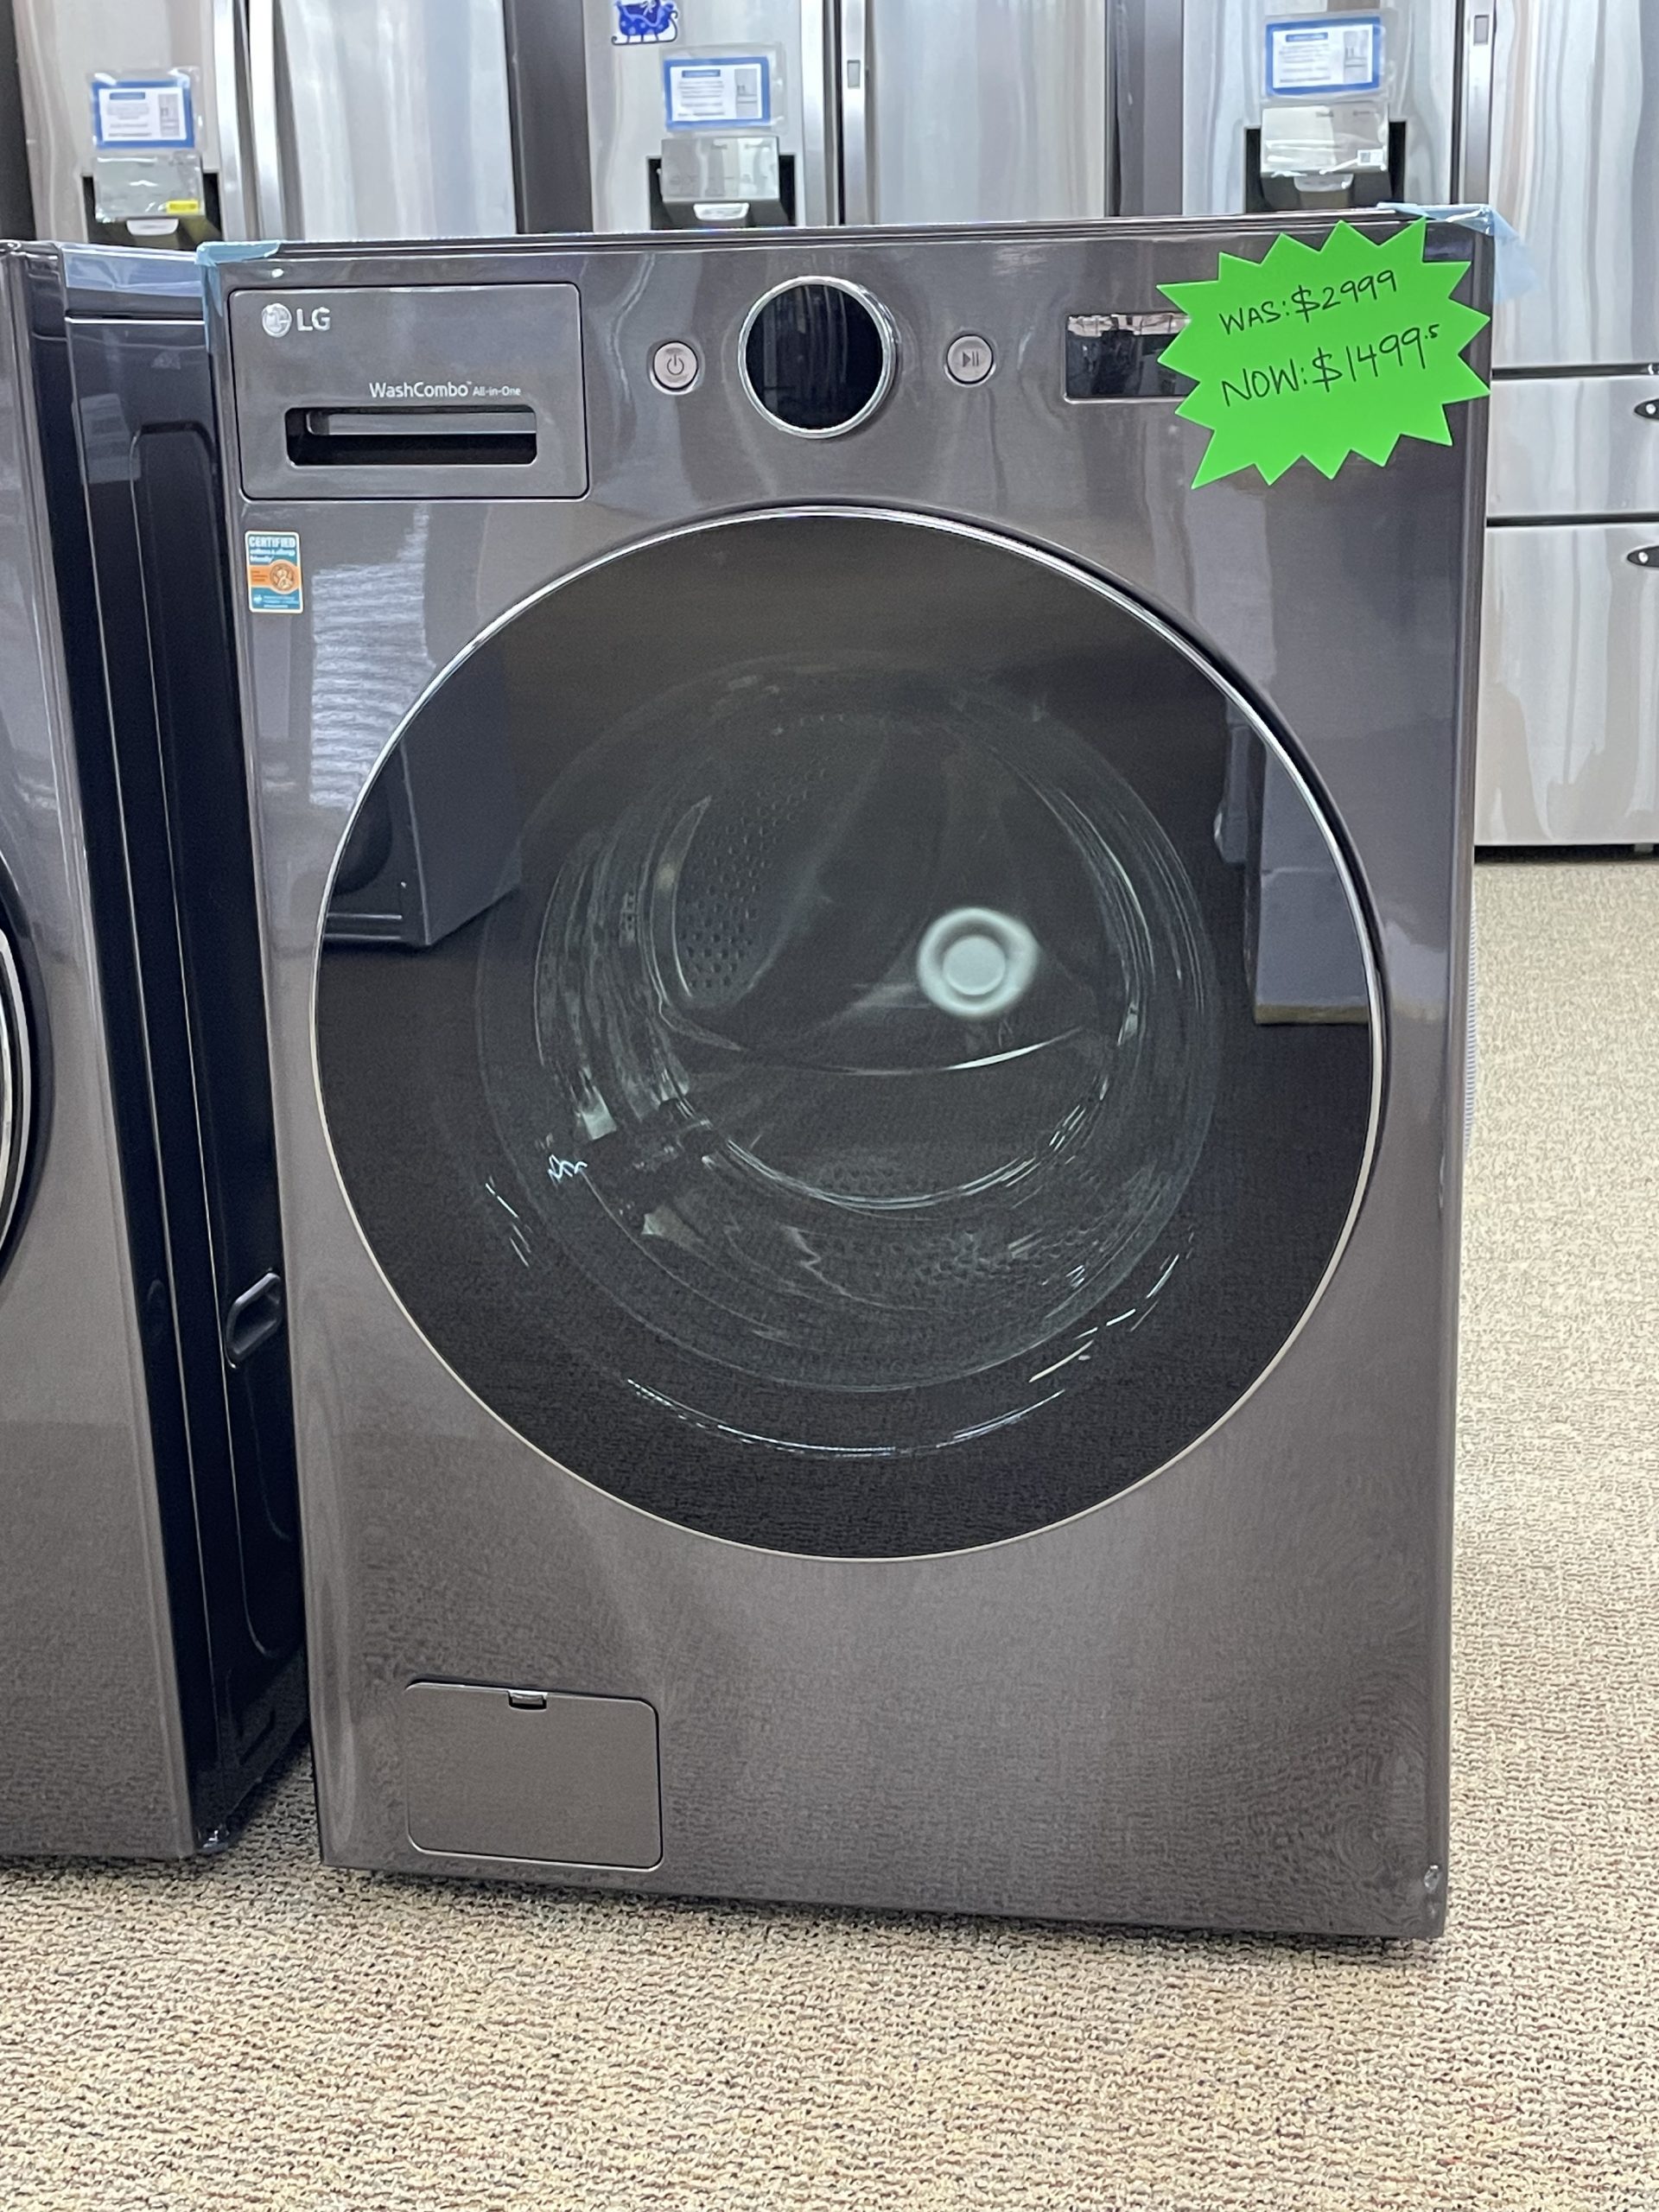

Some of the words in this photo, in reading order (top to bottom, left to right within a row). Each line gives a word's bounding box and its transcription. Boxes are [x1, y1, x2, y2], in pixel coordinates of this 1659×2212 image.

[296, 307, 331, 332] LG
[472, 385, 522, 397] All-in-One
[250, 536, 296, 547] CERTIFIED
